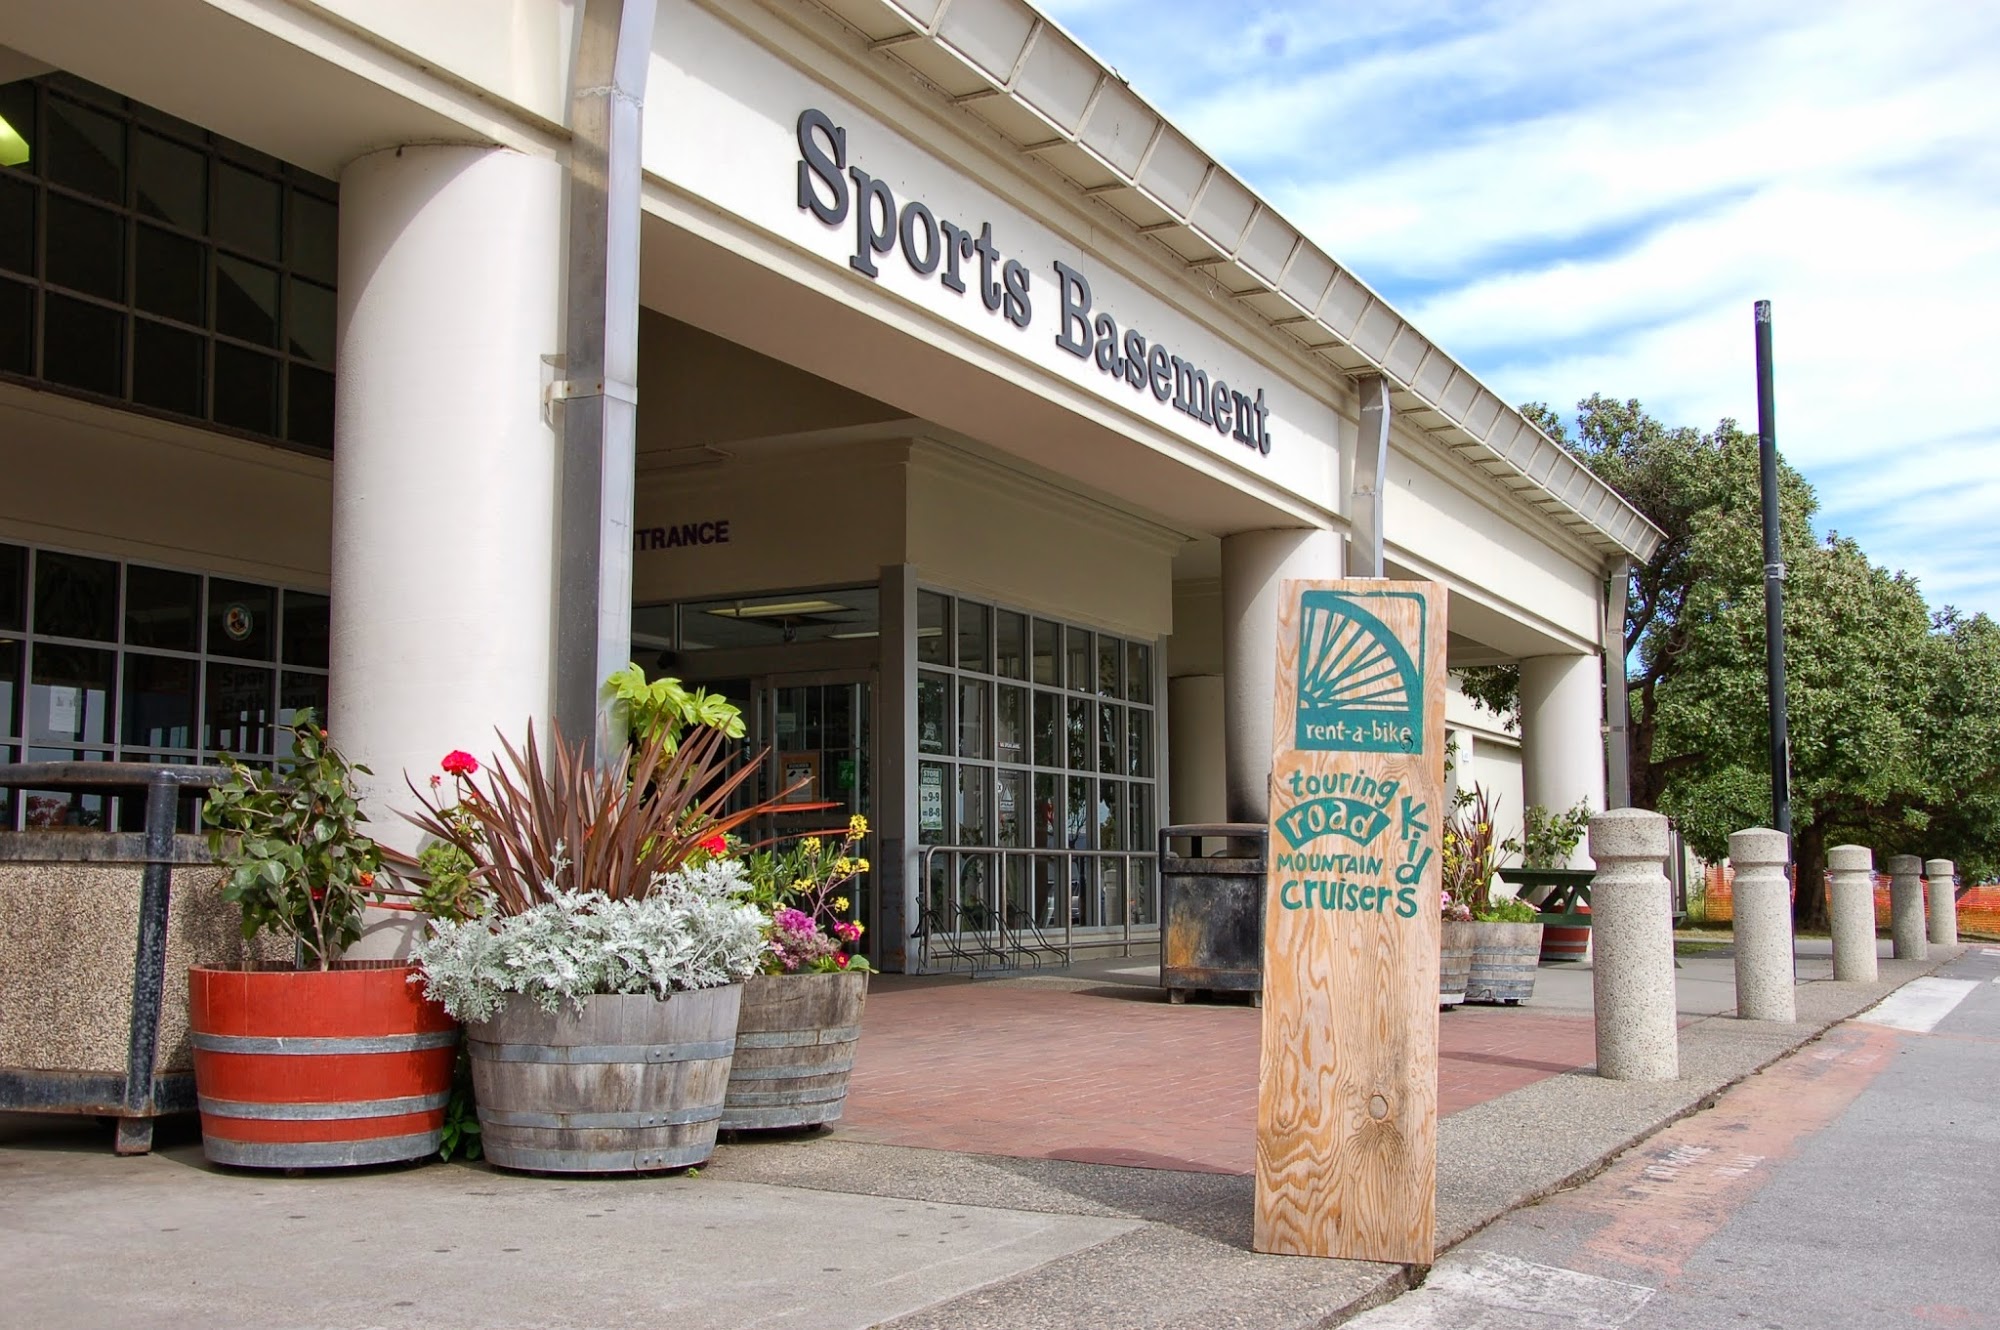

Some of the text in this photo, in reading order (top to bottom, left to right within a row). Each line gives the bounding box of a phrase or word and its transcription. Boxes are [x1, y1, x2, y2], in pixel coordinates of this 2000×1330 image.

[797, 108, 1271, 455] Sports Basement
[633, 520, 730, 551] TRANCE
[1305, 719, 1412, 743] rent-a-bike
[1289, 769, 1400, 809] touring
[1286, 801, 1378, 838] road
[1276, 852, 1383, 876] MOUNTAIN
